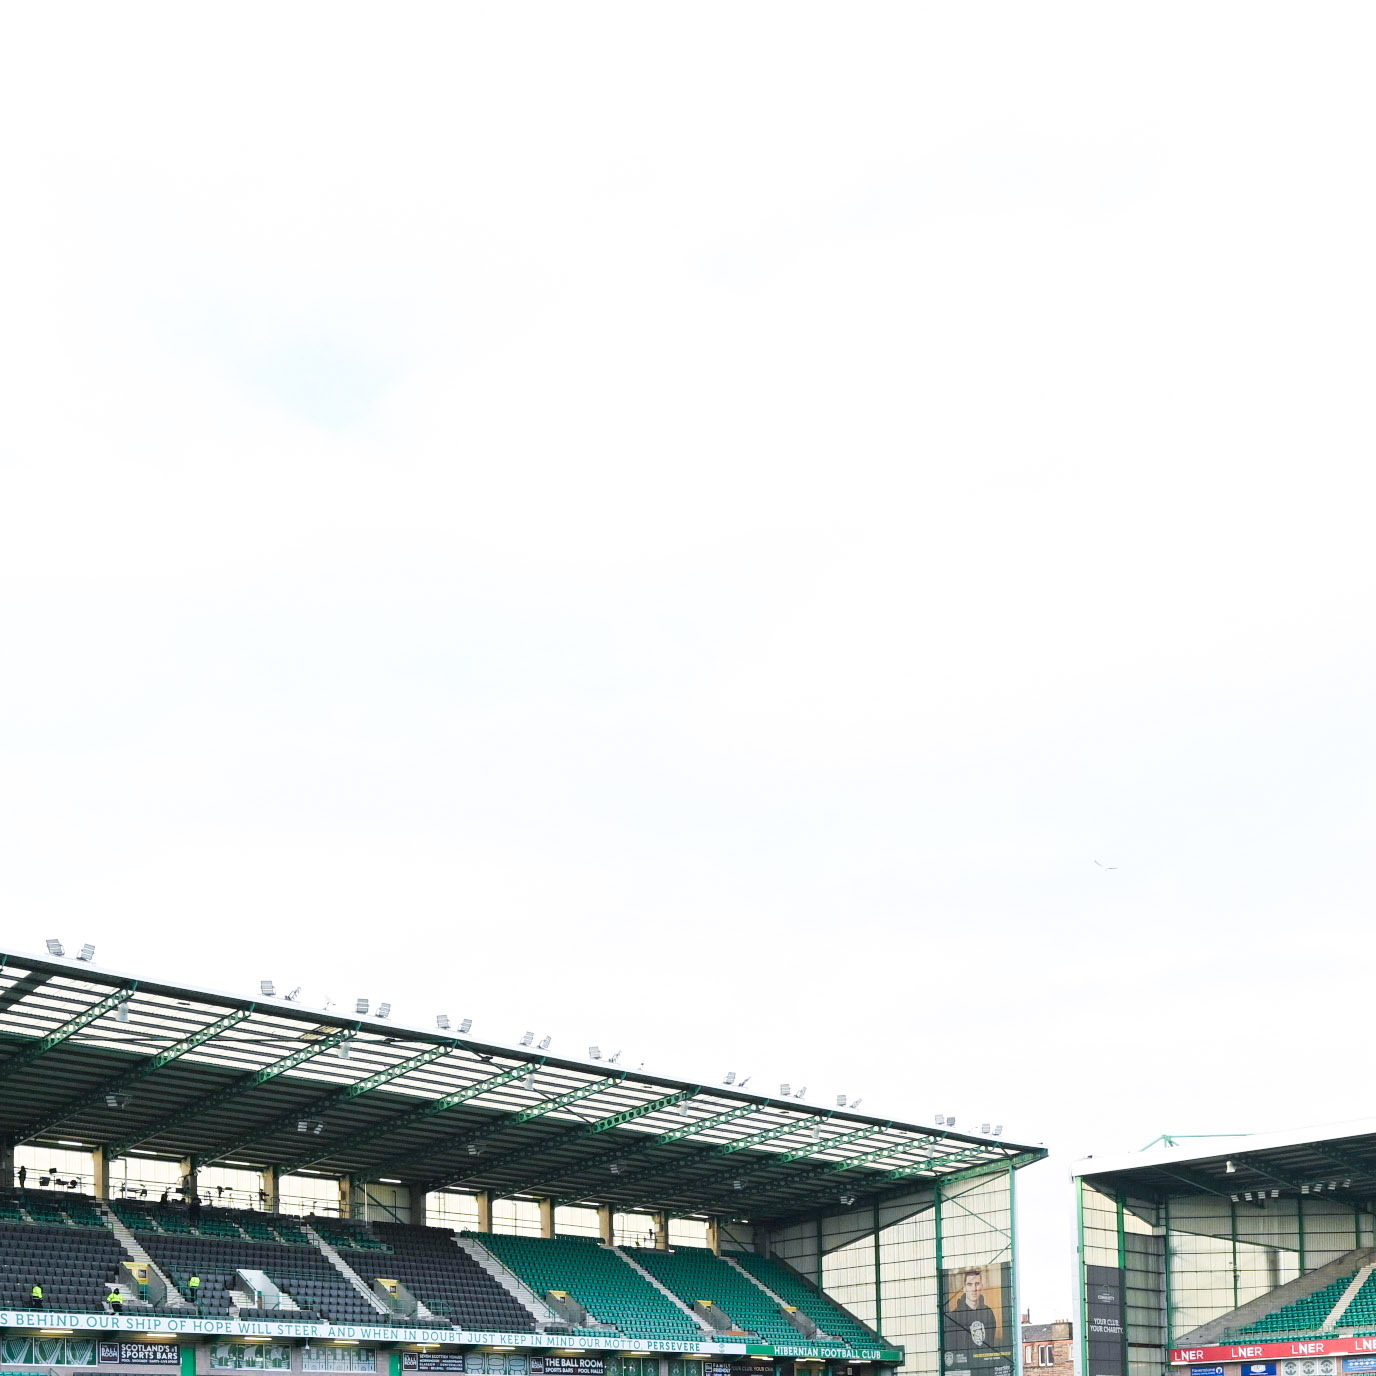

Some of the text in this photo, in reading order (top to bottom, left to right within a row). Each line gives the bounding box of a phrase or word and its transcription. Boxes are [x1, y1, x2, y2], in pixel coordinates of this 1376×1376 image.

[1093, 1317, 1105, 1325] YOUR
[86, 1316, 120, 1329] OUR
[126, 1318, 162, 1330] SHIP
[168, 1320, 186, 1331] OF
[193, 1320, 232, 1333] HOPE
[238, 1322, 272, 1335] WILL
[328, 1326, 356, 1338] AND
[360, 1328, 398, 1340] WHEN
[404, 1330, 416, 1341] IN
[422, 1331, 462, 1342] DOUBT
[468, 1332, 496, 1344] JUST
[500, 1334, 526, 1345] KEEP
[530, 1336, 542, 1346] IN
[546, 1336, 574, 1346] MIND
[578, 1338, 600, 1348] OUR
[647, 1340, 700, 1352] PERSEVERE
[1090, 1324, 1103, 1333] YOUR
[121, 1344, 170, 1352] SCOTLAND'S
[774, 1346, 881, 1360] HIBERNIAN FOOTBALL CLUB
[1231, 1346, 1263, 1358] LNER
[1291, 1342, 1324, 1356] LNER
[121, 1351, 178, 1360] SPORTS BARS
[1174, 1350, 1204, 1362] LNER
[544, 1358, 604, 1368] THE BALL ROOM
